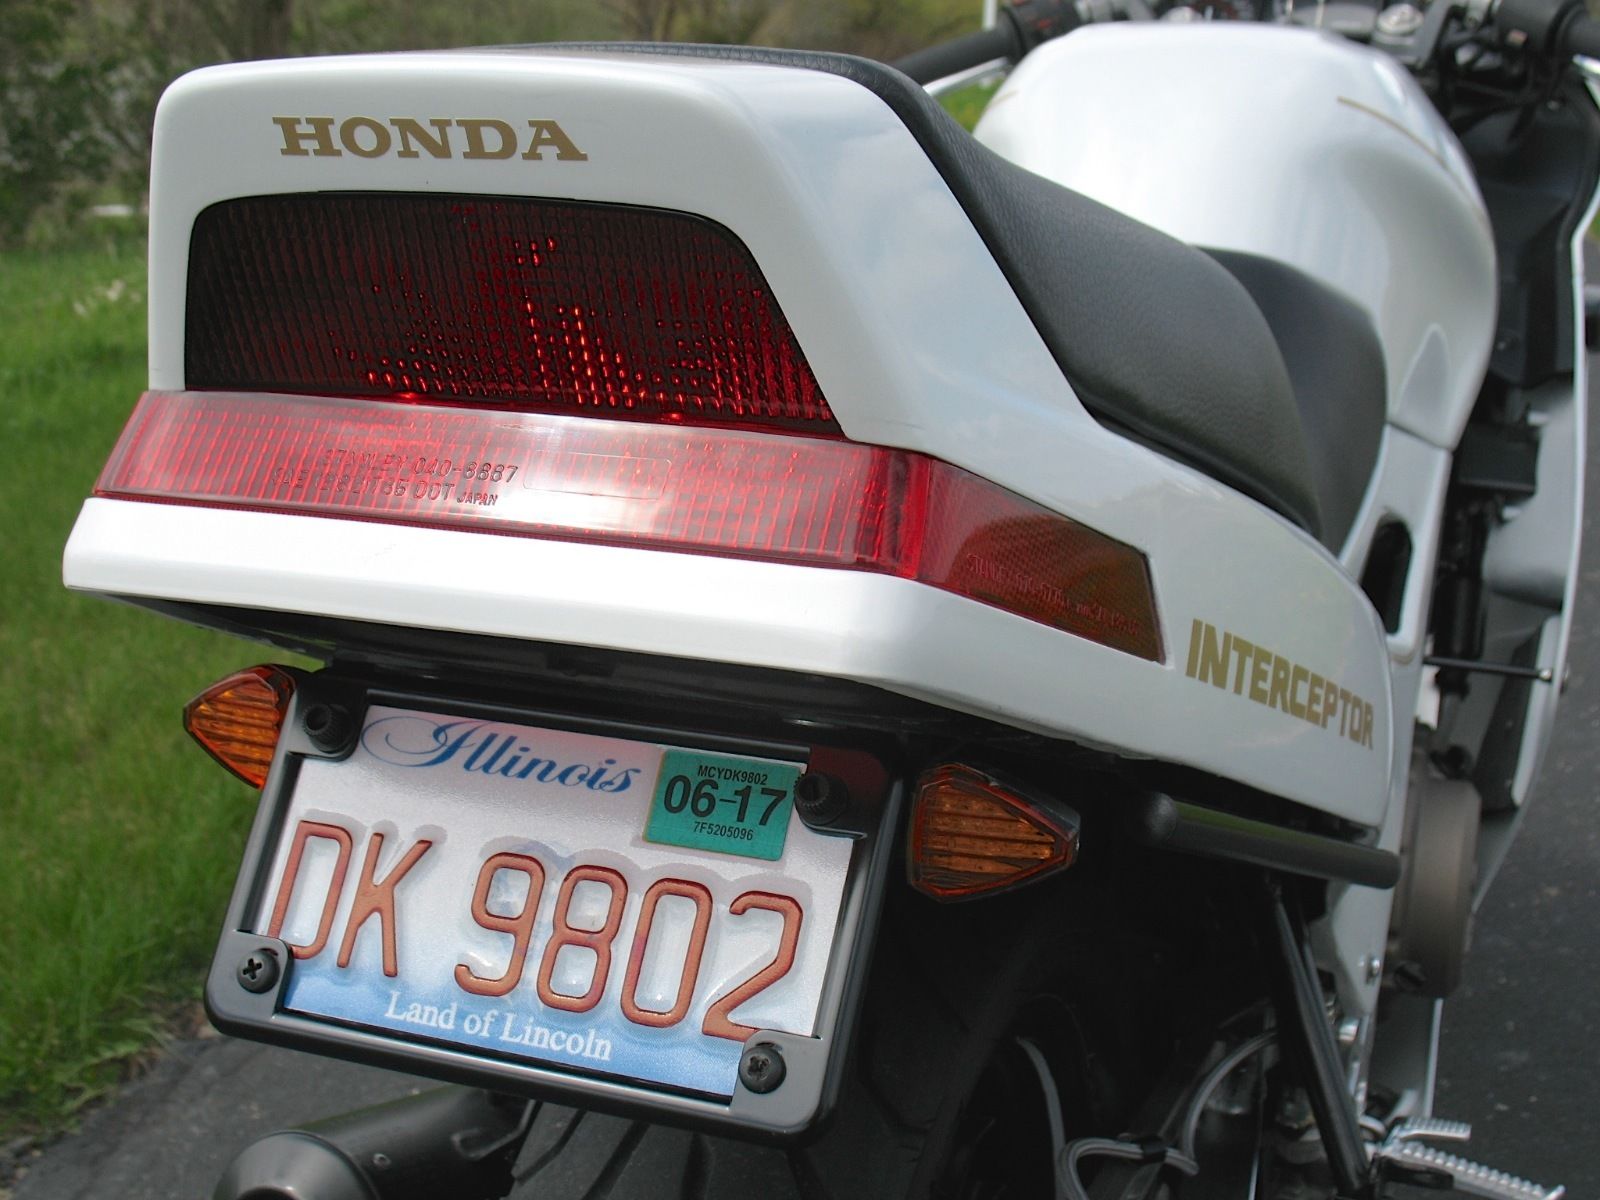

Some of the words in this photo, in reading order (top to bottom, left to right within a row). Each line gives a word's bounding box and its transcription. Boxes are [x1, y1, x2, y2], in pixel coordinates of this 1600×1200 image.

[272, 116, 589, 162] HONDA
[456, 491, 499, 506] JAPAN
[1185, 618, 1374, 751] INTERCEPTOR
[360, 714, 642, 793] Illinois
[697, 765, 768, 786] MCYDK9802
[663, 774, 788, 826] 06-17
[693, 821, 754, 841] 7F5205096
[267, 819, 433, 978] DK
[453, 851, 804, 1042] 9802
[385, 990, 455, 1031] Land
[463, 1010, 499, 1039] of
[501, 1013, 613, 1061] Lincoln
